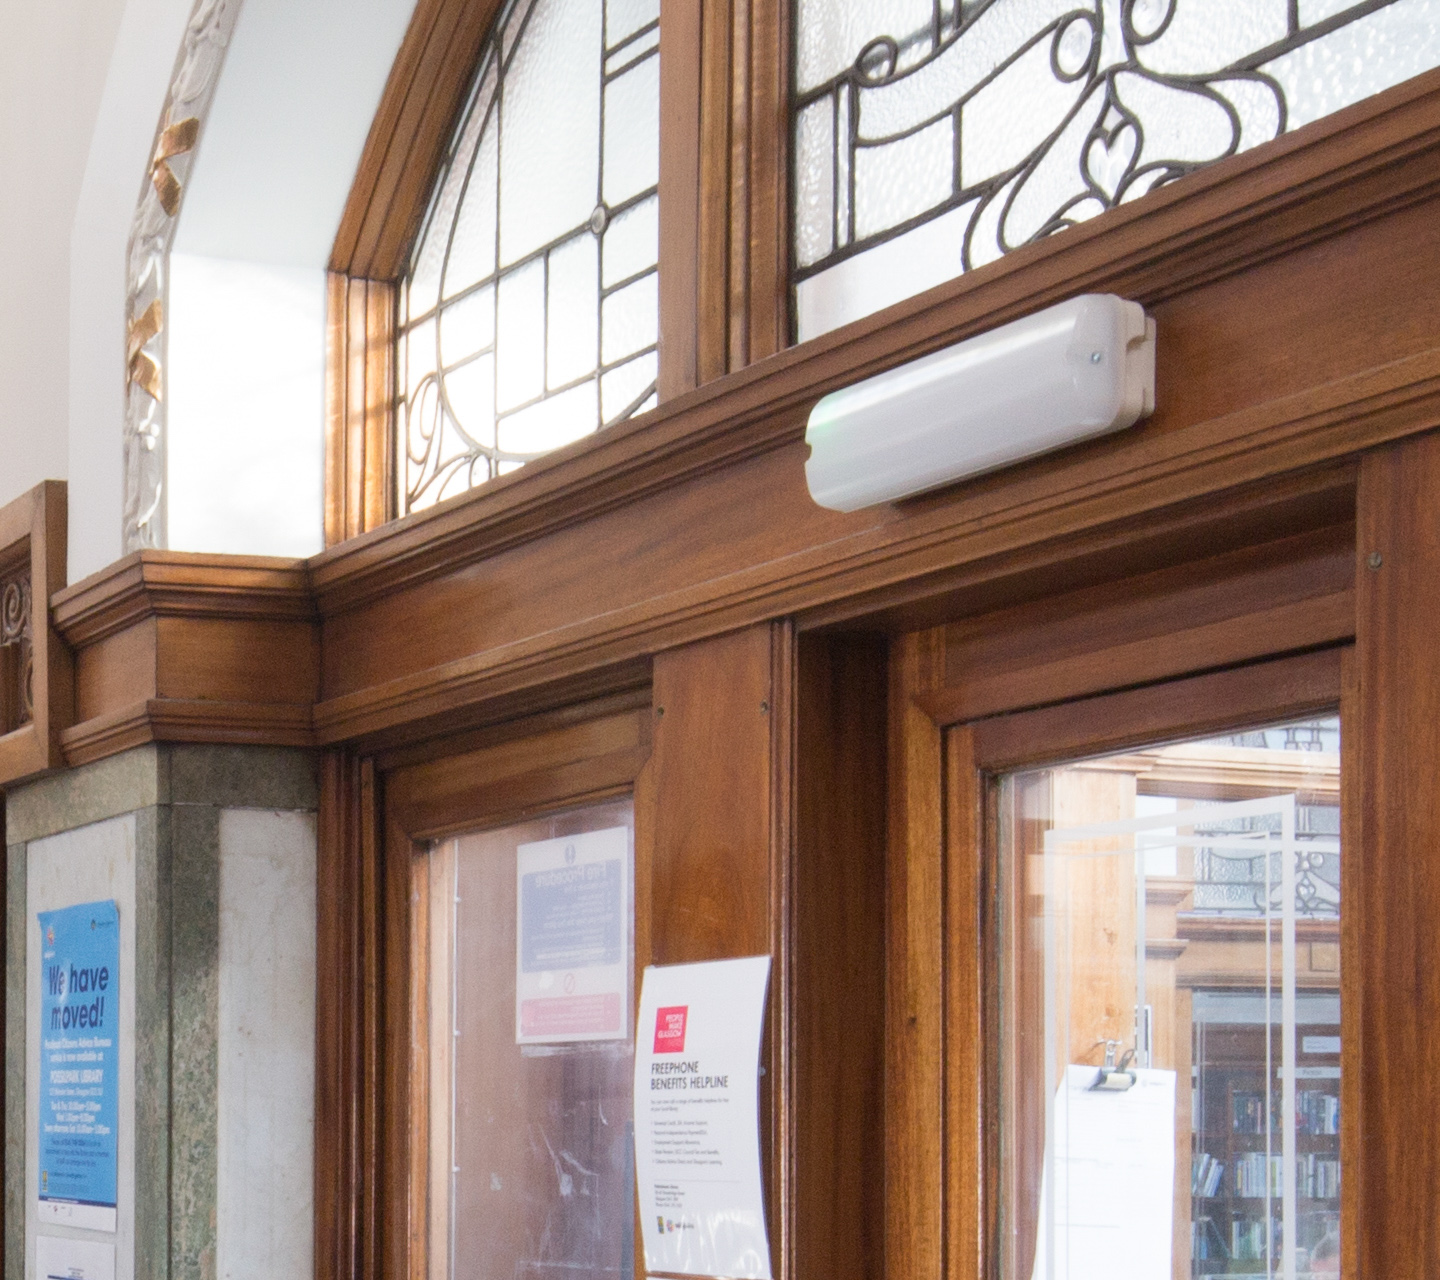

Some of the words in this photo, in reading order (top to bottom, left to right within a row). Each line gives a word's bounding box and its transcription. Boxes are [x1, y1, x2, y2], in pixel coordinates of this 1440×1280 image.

[49, 965, 65, 995] We
[69, 963, 109, 993] have
[51, 996, 105, 1030] moved!
[666, 1013, 684, 1023] PEOPLE
[657, 1029, 682, 1039] GLASGOW
[650, 1061, 699, 1074] FREEPHONE
[650, 1076, 688, 1090] BENEFITS
[689, 1075, 729, 1089] HELPLINE
